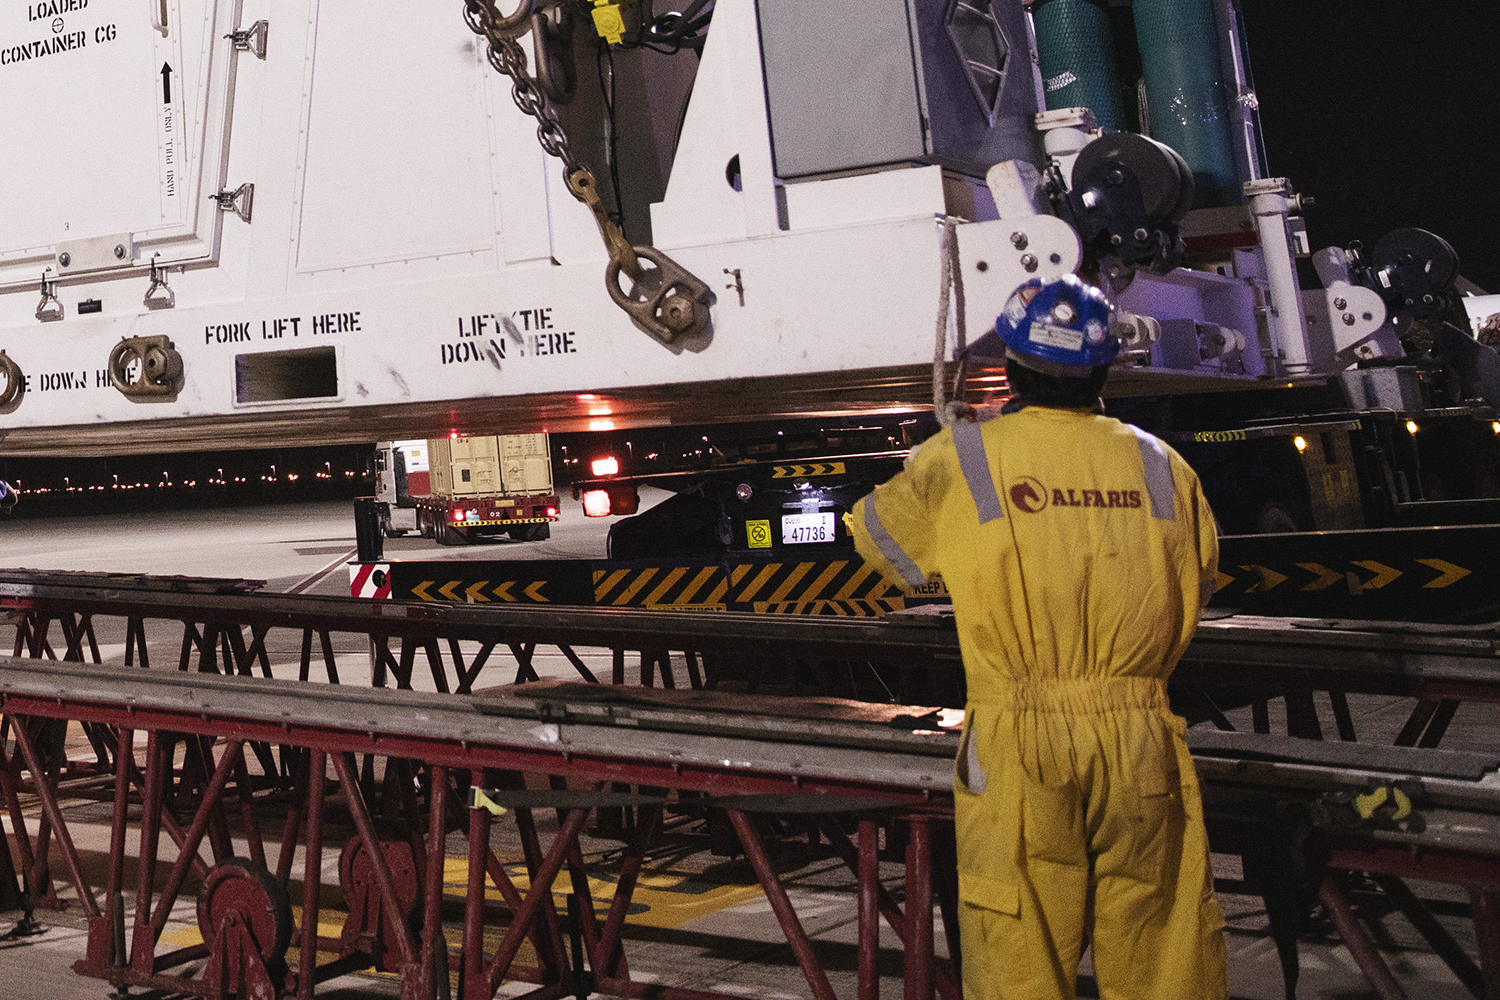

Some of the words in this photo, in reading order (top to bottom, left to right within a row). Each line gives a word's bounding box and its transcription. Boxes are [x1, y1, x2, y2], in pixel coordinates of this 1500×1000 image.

[1, 30, 86, 65] CONTAINER
[95, 24, 117, 43] CG
[164, 106, 173, 132] ONLY
[165, 138, 174, 165] PULL
[166, 170, 175, 197] HAND
[205, 321, 252, 345] FORK
[261, 317, 301, 340] LIFT
[313, 311, 362, 335] HERE
[441, 338, 506, 365] DOWN
[40, 371, 87, 392] DOWN
[1052, 488, 1142, 509] ALFARIS
[792, 526, 826, 541] 47736
[914, 582, 941, 596] KEEP
